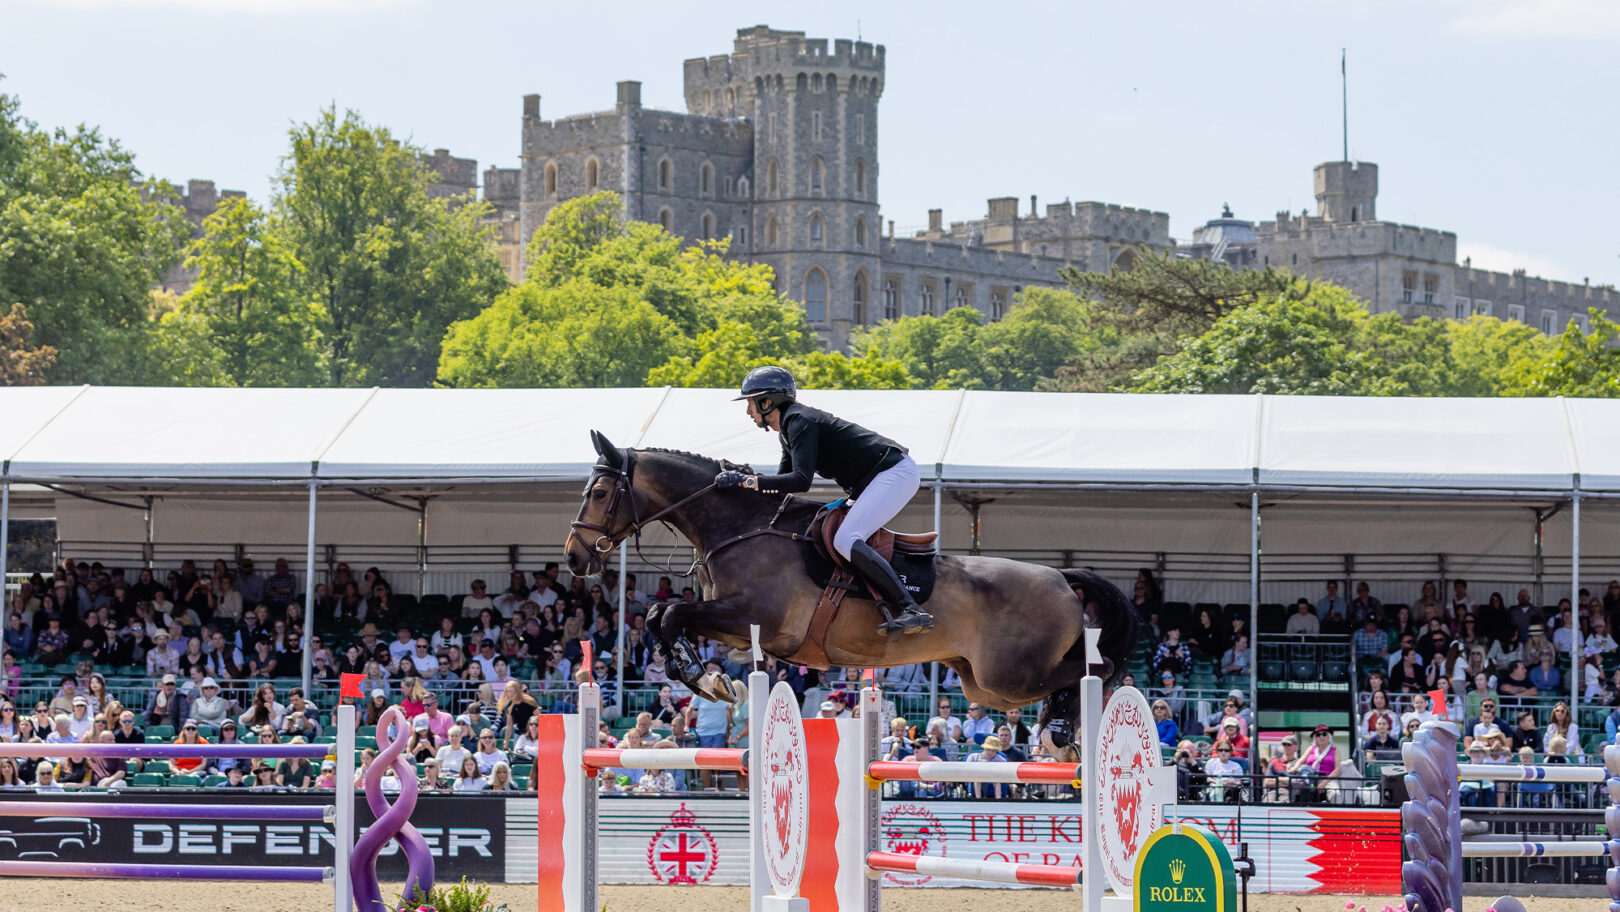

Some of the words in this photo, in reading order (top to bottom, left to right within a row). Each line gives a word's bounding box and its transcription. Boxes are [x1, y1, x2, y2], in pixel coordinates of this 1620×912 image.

[133, 823, 493, 857] DEFENER
[963, 815, 1038, 843] THE
[1150, 886, 1207, 903] ROLEX
